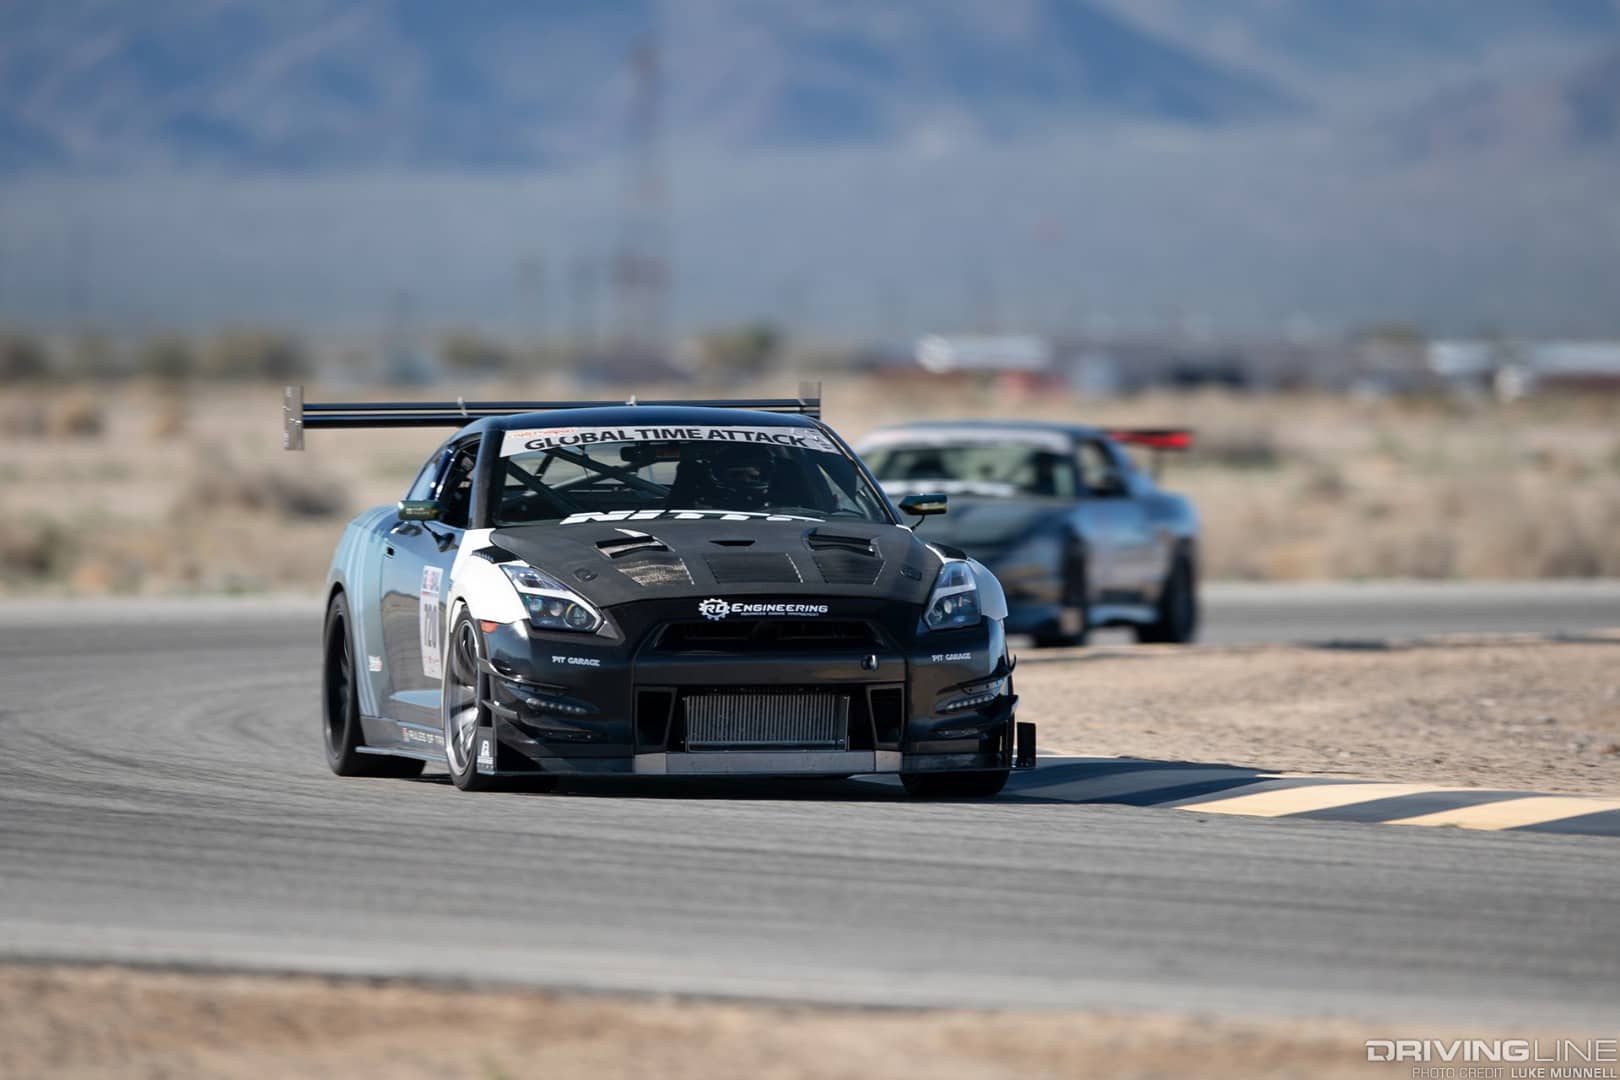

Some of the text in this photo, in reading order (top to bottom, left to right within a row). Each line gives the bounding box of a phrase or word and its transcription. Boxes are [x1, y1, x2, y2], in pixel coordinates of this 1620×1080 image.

[524, 430, 634, 451] GLOBAL
[635, 428, 705, 440] TIME
[707, 430, 809, 447] ATTACK
[552, 656, 601, 667] PIT GARAGE
[931, 652, 972, 663] PIT GARAGE
